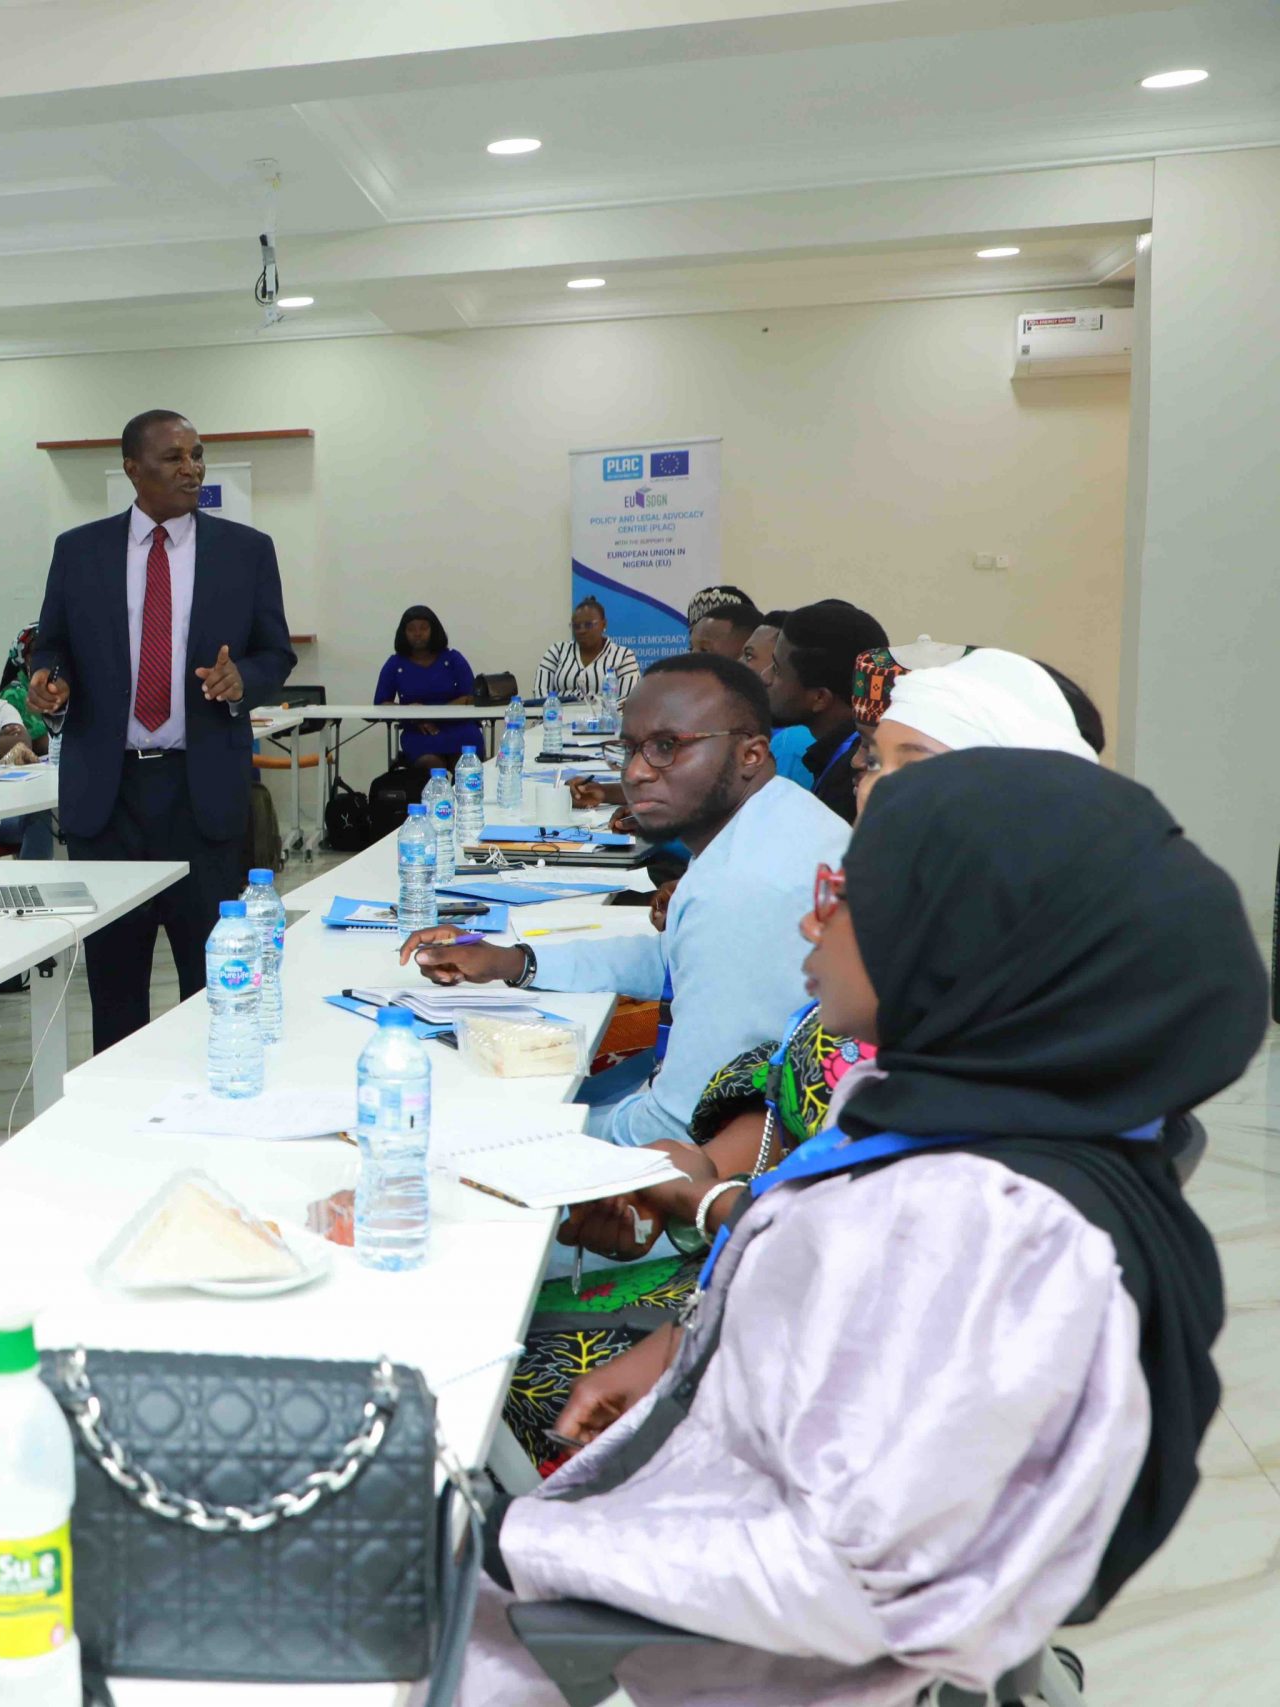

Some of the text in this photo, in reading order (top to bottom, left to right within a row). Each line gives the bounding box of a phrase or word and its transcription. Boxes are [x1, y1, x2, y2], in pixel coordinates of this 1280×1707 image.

[607, 458, 639, 473] PLAC
[624, 496, 635, 508] EU
[590, 510, 704, 525] POLICY AND LEGAL ADVOCACY
[618, 523, 676, 533] CENTRE (PLAC)
[607, 547, 686, 559] EUROPEAN UNION IN
[622, 559, 672, 568] NIGERIA (EU)
[640, 634, 687, 645] DEMOCRACY
